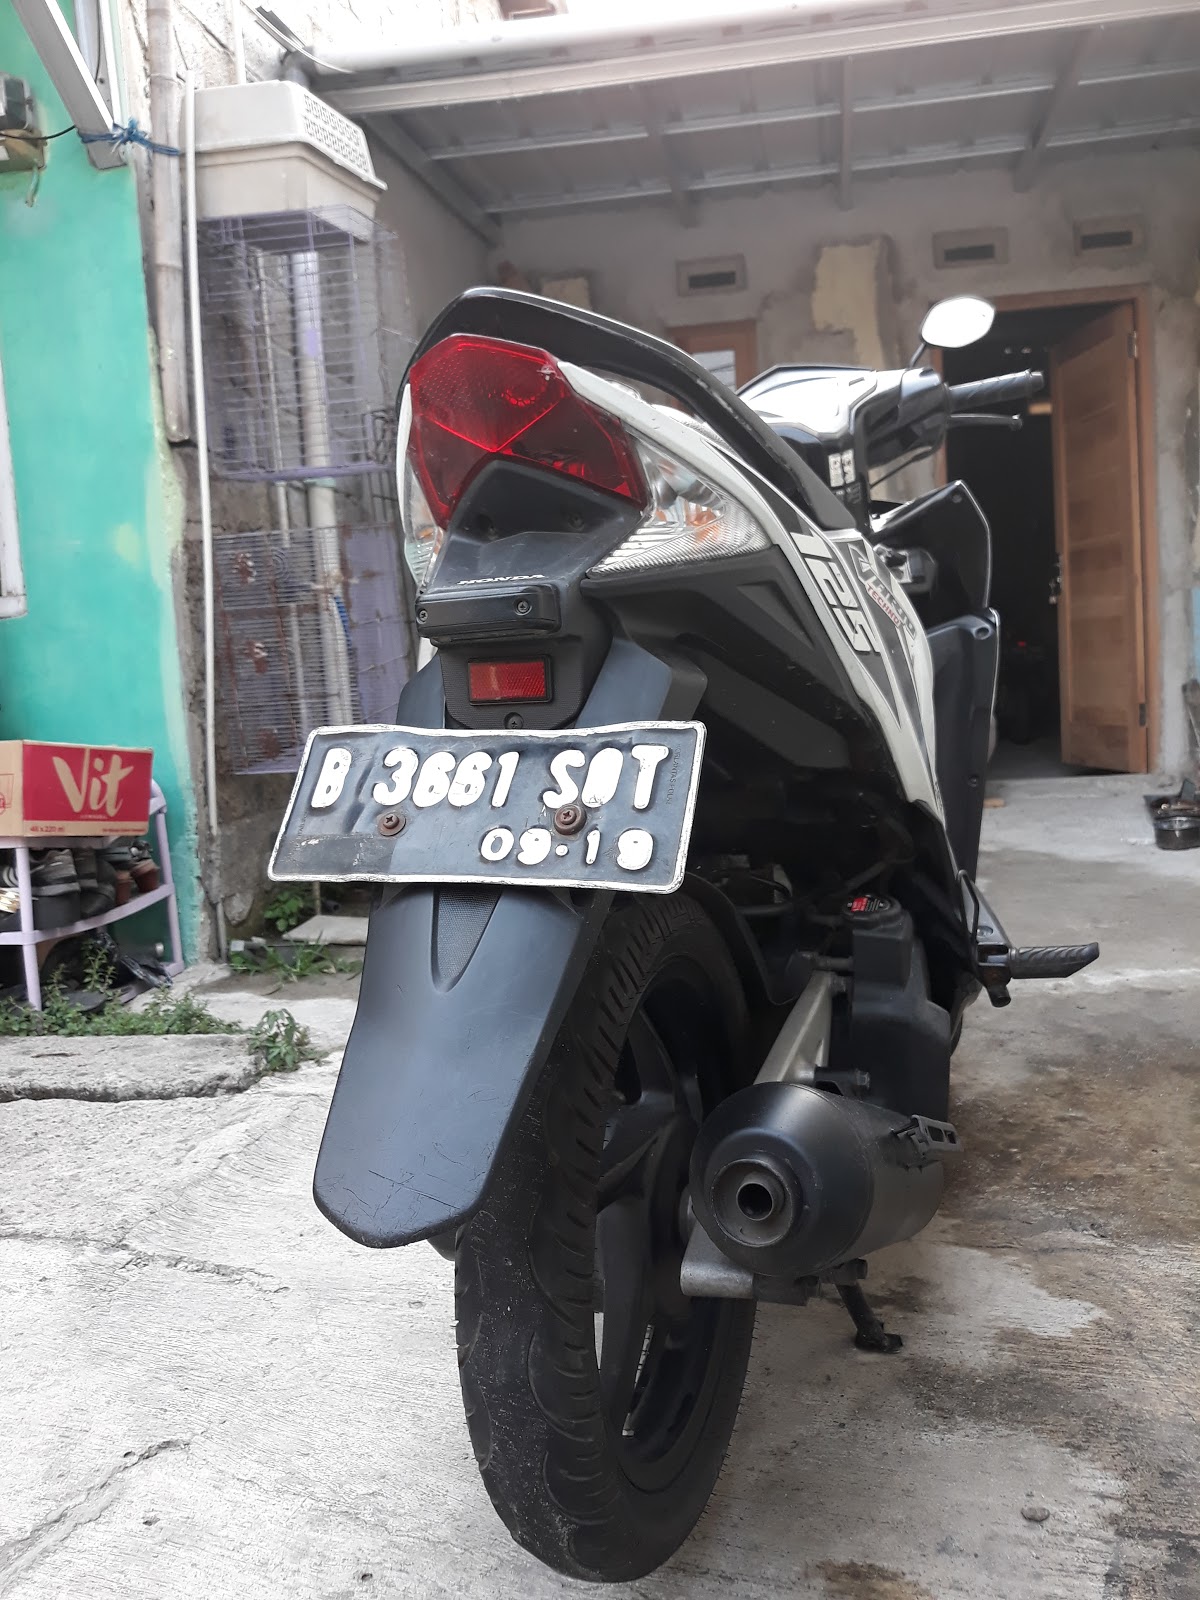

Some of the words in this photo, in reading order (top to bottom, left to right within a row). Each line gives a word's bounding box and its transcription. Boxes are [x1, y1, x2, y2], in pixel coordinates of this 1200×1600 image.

[457, 574, 545, 585] HONDA
[790, 530, 881, 653] 125
[866, 583, 901, 627] TECHNO
[52, 749, 134, 817] Vit
[311, 747, 352, 808] B
[373, 746, 520, 808] 3661
[543, 744, 670, 810] SOT
